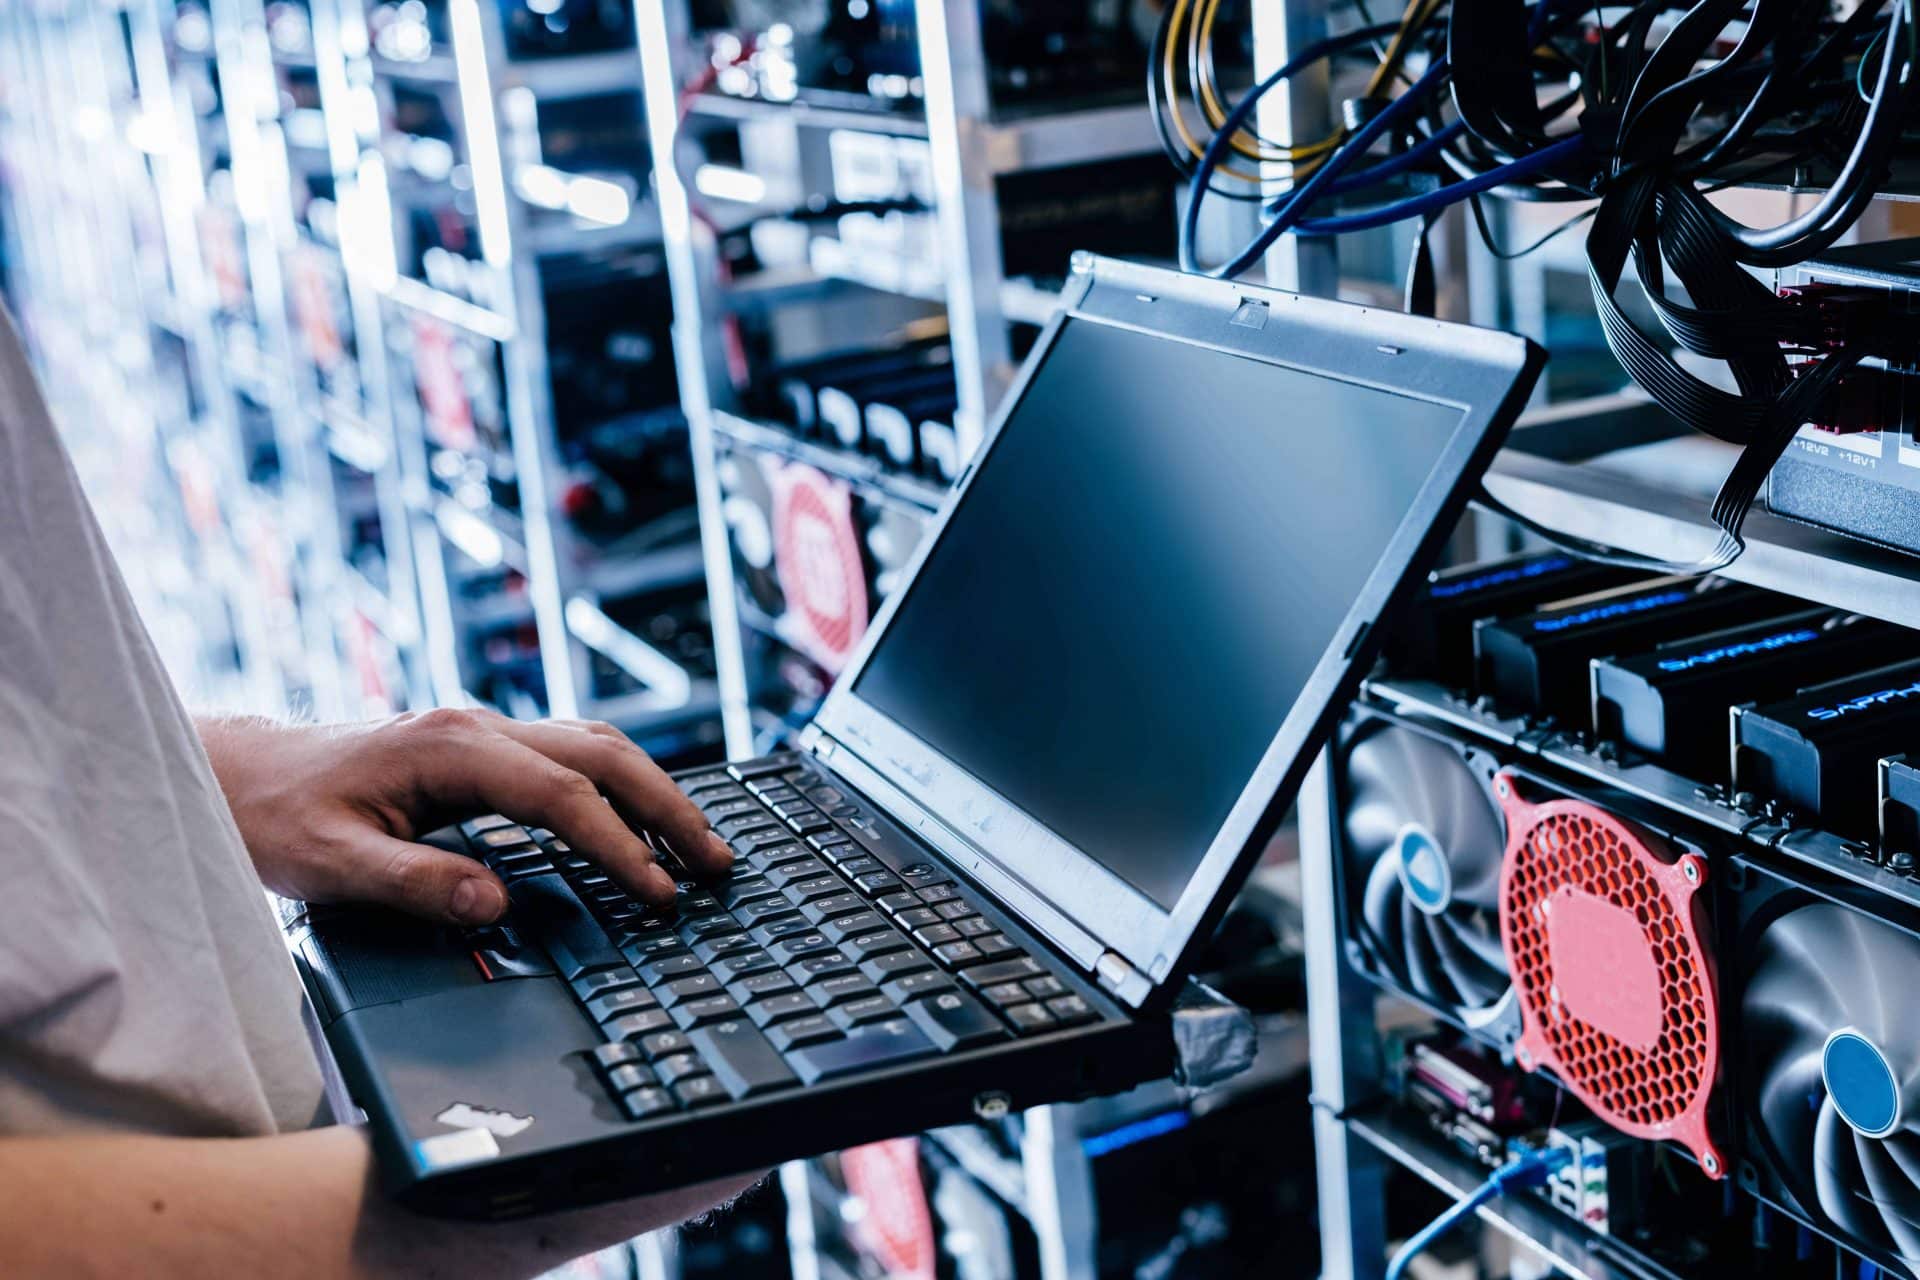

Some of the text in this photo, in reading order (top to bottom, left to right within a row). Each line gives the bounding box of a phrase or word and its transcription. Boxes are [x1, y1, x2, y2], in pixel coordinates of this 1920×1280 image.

[1793, 439, 1876, 469] +12V2 +12V1
[750, 880, 768, 888] Y
[694, 898, 713, 908] H
[767, 898, 785, 907] U
[641, 919, 661, 928] N
[727, 933, 747, 943] K
[823, 954, 843, 963] P
